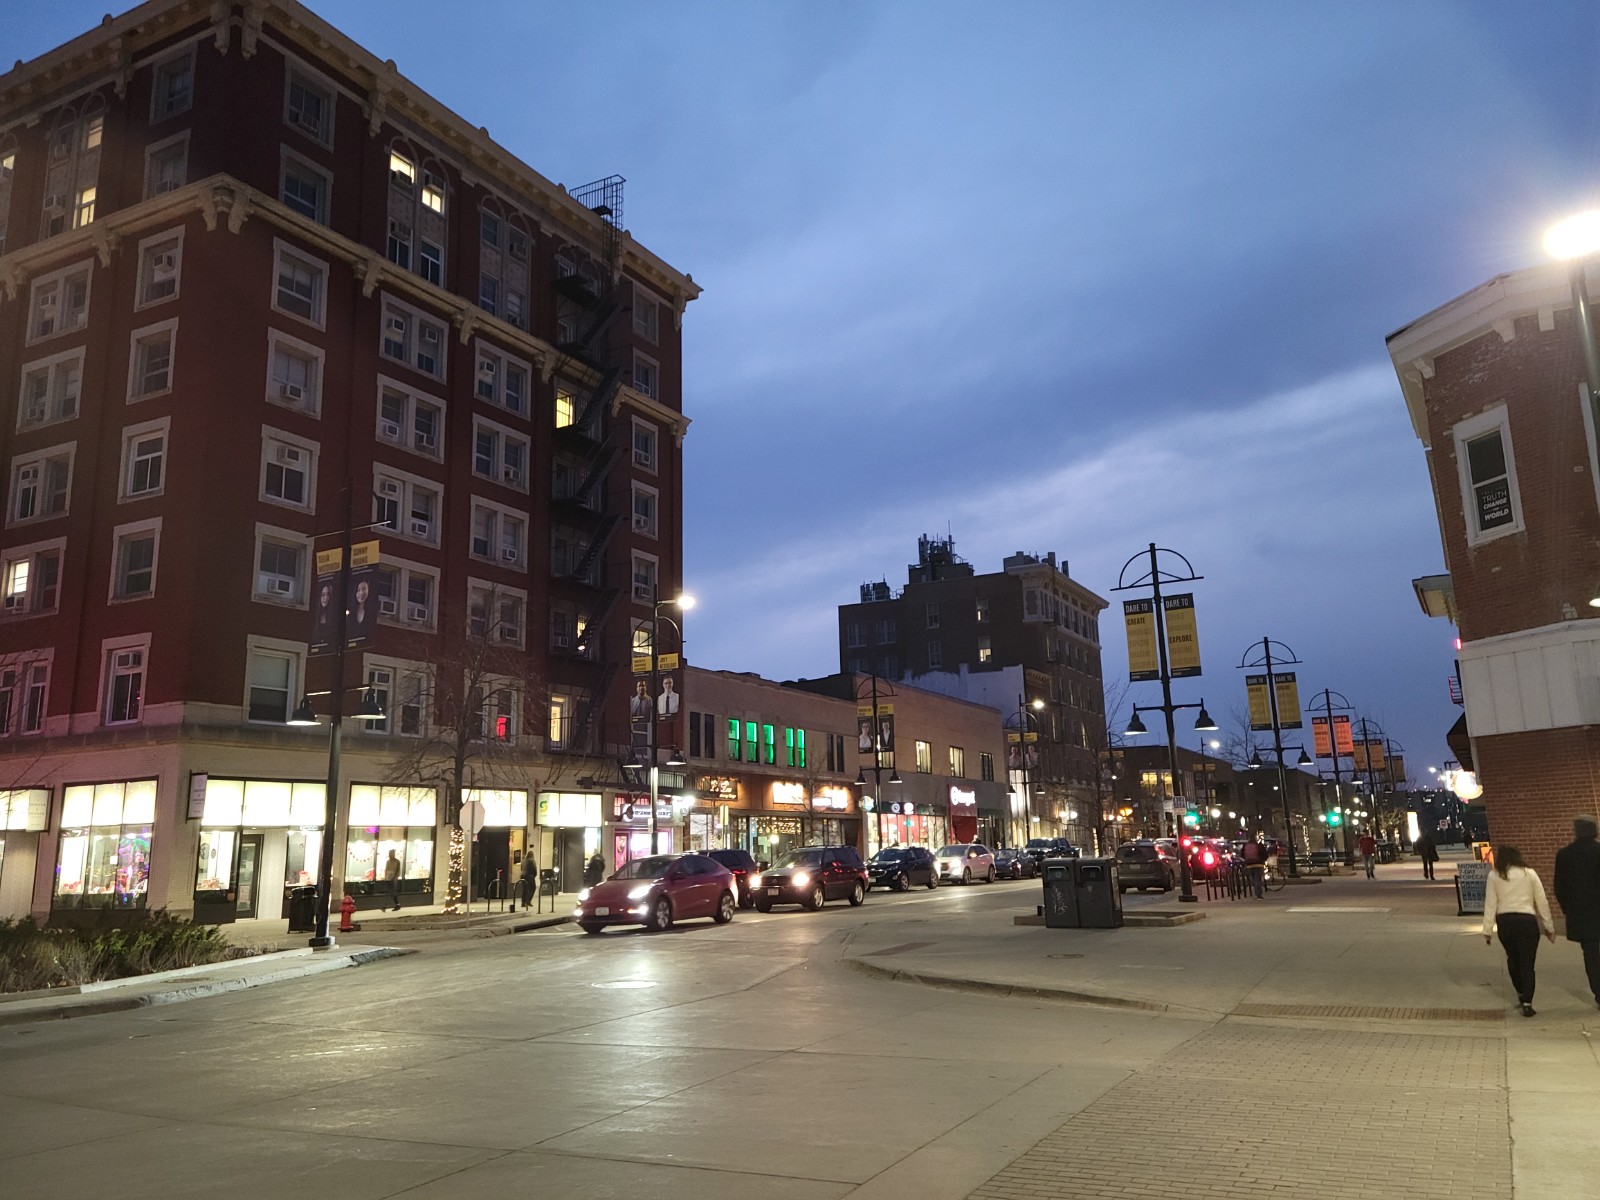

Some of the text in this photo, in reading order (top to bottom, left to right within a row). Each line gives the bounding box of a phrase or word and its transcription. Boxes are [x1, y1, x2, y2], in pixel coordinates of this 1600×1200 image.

[1482, 490, 1507, 503] TRUTH
[1482, 498, 1508, 510] CHANGE
[1484, 508, 1510, 521] WORLD
[1125, 603, 1148, 613] DARE TO
[1165, 598, 1189, 608] DARE TO
[1127, 617, 1146, 626] CREATE
[1169, 634, 1193, 644] EXPLORE
